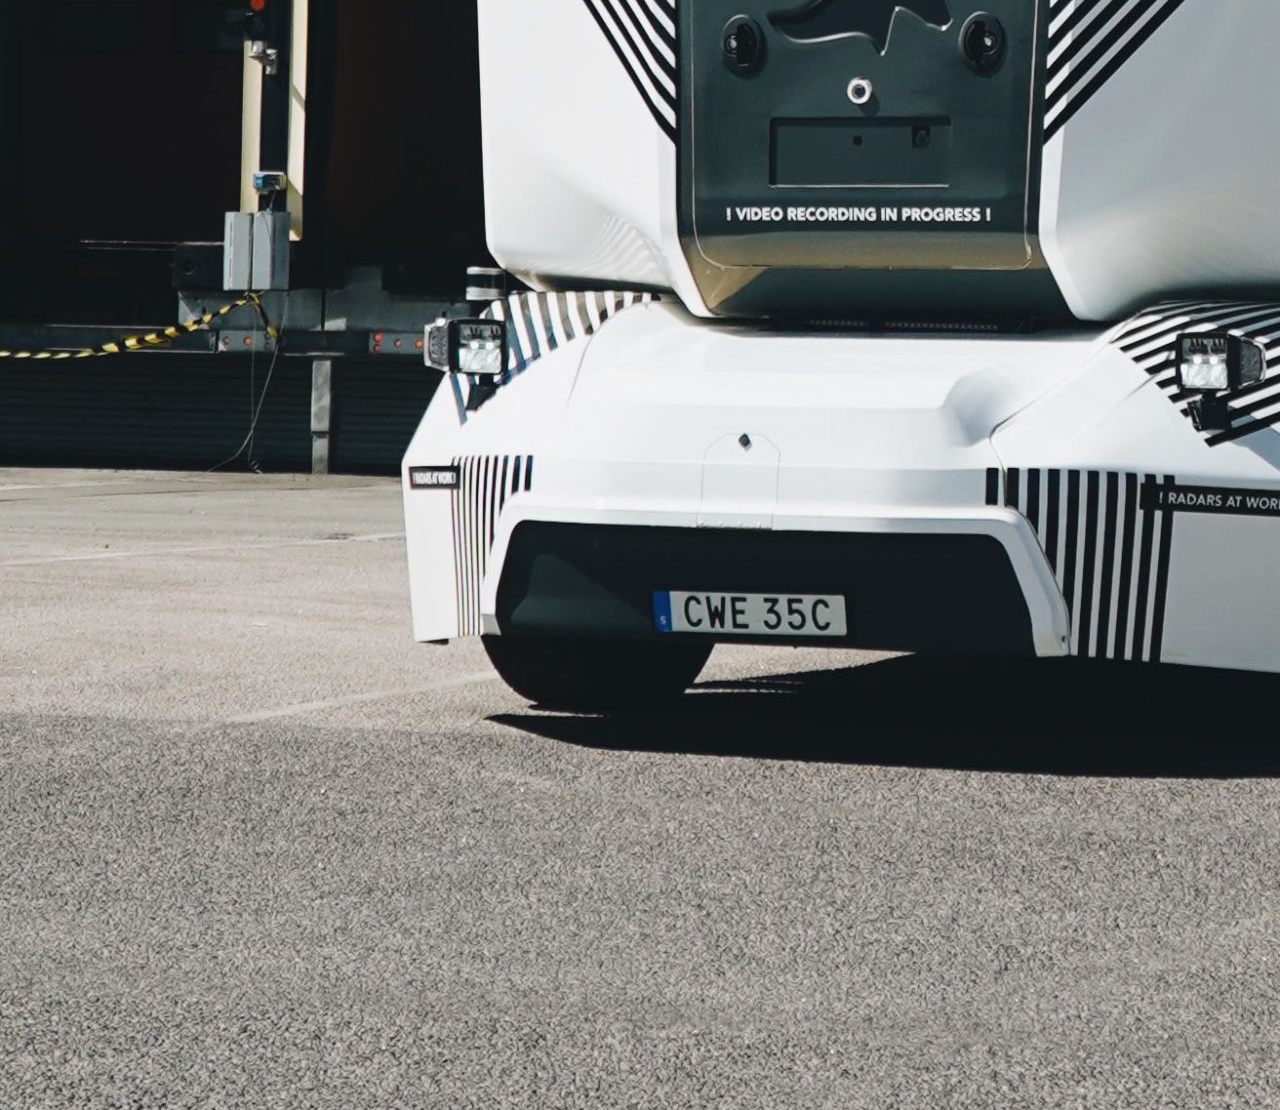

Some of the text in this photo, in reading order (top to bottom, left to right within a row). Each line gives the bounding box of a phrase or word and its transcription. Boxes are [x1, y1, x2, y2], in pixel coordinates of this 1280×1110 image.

[736, 207, 783, 221] VIDEO
[787, 207, 876, 221] RECORDING
[881, 207, 898, 221] IN
[902, 207, 981, 222] PROGRESS
[1168, 492, 1222, 507] RADARS
[1226, 495, 1242, 508] AT
[659, 595, 831, 631] S CWE 35C
